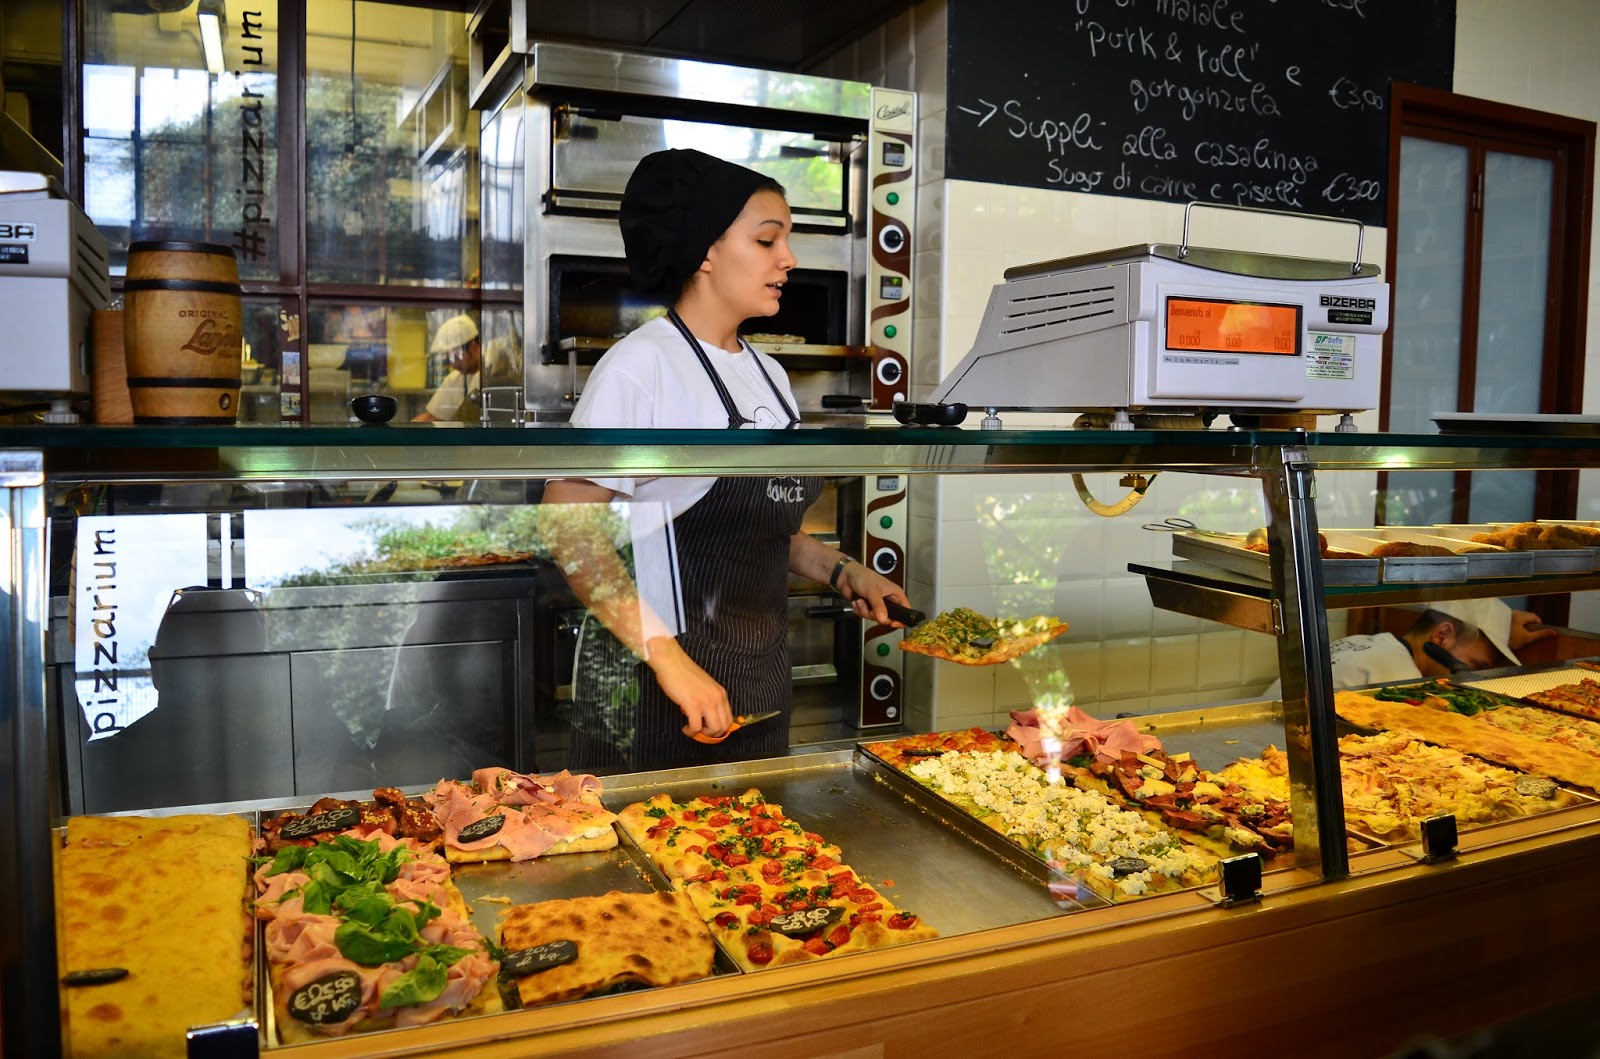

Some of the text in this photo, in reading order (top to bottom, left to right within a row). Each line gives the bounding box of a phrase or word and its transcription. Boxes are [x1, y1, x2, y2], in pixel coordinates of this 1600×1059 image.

[1165, 32, 1182, 62] &
[1130, 78, 1281, 120] gorgonzola
[232, 10, 270, 262] #pizzarium
[1122, 126, 1177, 160] alla
[1195, 138, 1319, 184] casalinga
[1046, 159, 1104, 192] Sugo
[1113, 162, 1131, 190] di
[1232, 180, 1303, 208] piselli
[178, 309, 229, 320] ORIGINAL
[1320, 296, 1376, 309] BIZERBA
[86, 528, 125, 734] pizzarium
